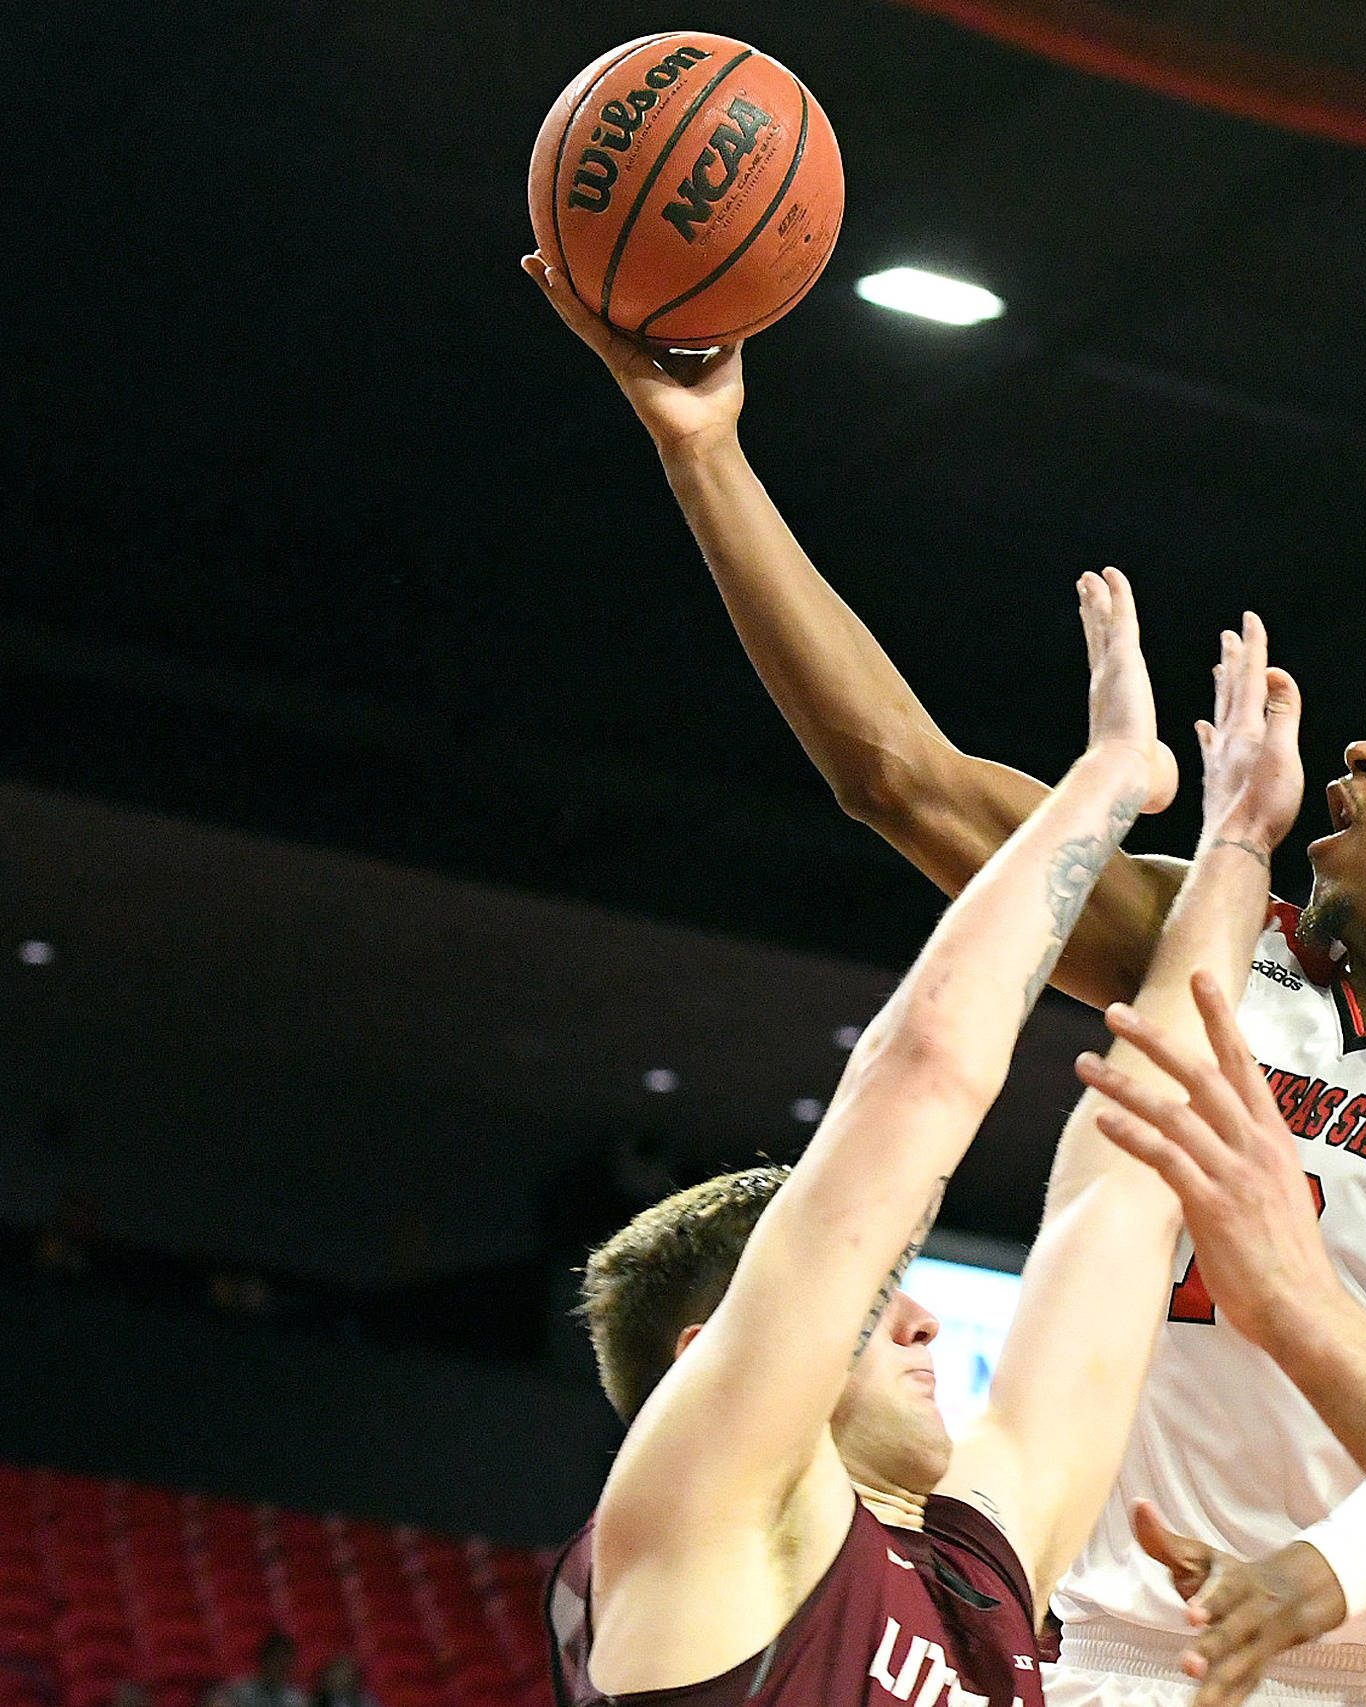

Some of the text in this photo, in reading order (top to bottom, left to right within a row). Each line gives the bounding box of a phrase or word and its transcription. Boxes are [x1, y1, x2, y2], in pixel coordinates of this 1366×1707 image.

[568, 46, 713, 214] Wilson
[662, 97, 772, 245] NCAA
[737, 153, 763, 190] GAME
[1252, 959, 1303, 991] adidas
[1259, 1063, 1348, 1140] NSAS
